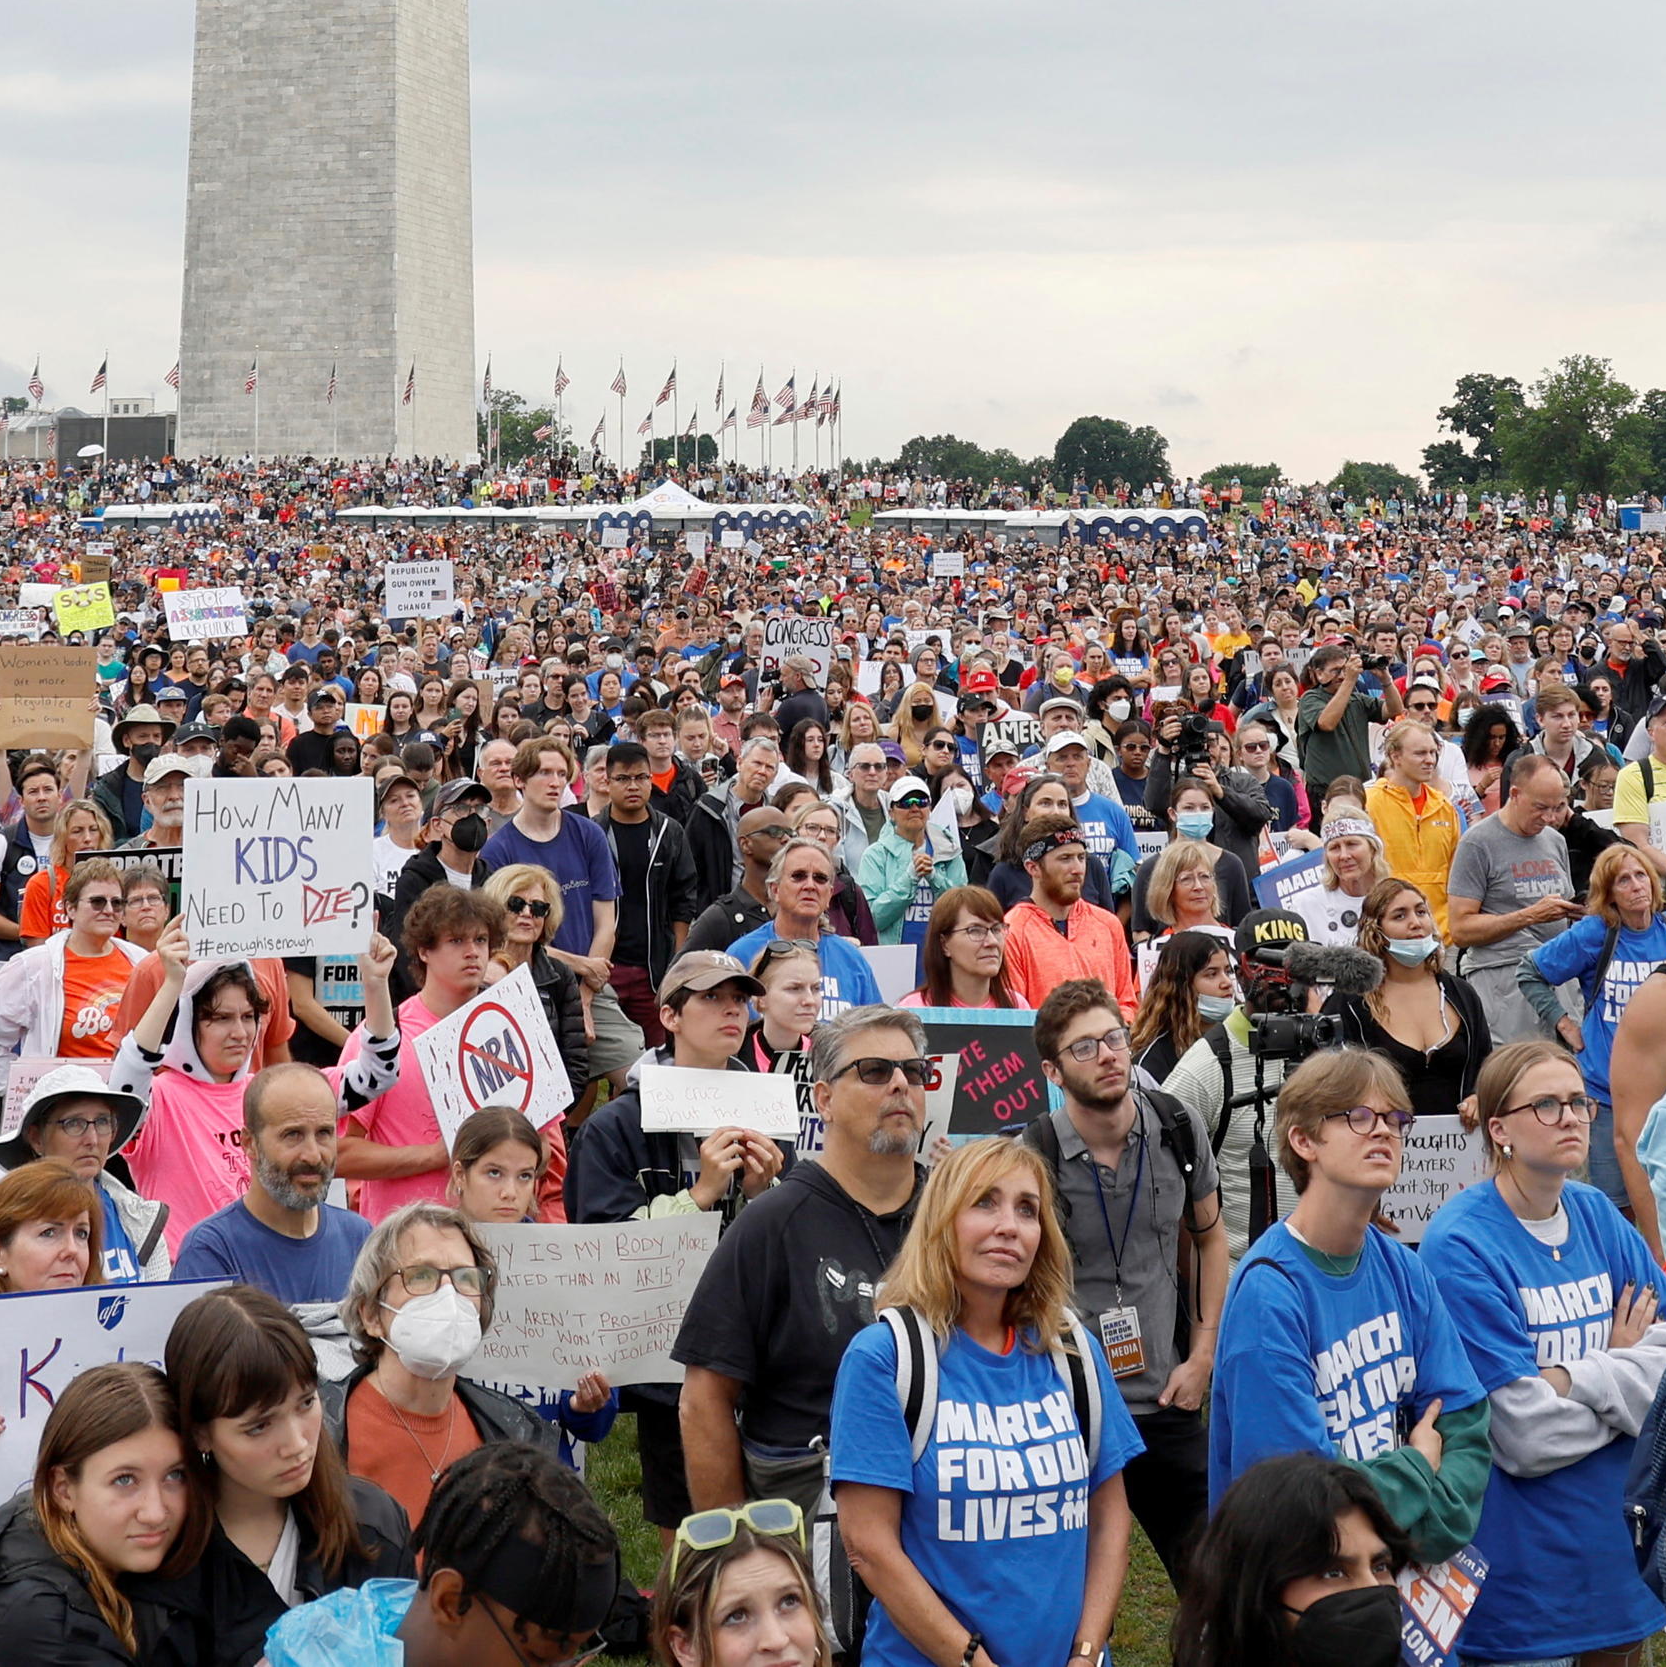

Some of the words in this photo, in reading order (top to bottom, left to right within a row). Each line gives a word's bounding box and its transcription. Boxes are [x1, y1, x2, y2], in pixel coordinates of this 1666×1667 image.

[391, 566, 440, 575] REPUBLICAN
[392, 580, 407, 588] GUN
[410, 579, 436, 587] OWNER
[177, 589, 228, 607] STOP
[408, 590, 424, 598] FOR
[398, 603, 431, 611] CHANGE
[765, 617, 832, 648] CONGRESS
[0, 655, 61, 669] Women's
[14, 677, 30, 686] are
[38, 676, 68, 686] more
[14, 695, 71, 710] Regulated
[11, 716, 35, 725] than
[982, 721, 1045, 747] AMER
[195, 789, 258, 833] HOW
[235, 836, 317, 885] KIDS
[1510, 859, 1558, 878] LOVE
[186, 888, 245, 932] NEED
[302, 882, 369, 929] DIE?
[1254, 918, 1304, 943] KING
[195, 937, 315, 957] #enoughisenough
[323, 965, 358, 982] FOR
[72, 1007, 113, 1038] Be
[469, 1026, 526, 1101] NRA
[962, 1051, 1026, 1102] THEM
[645, 1088, 674, 1102] Ted
[993, 1078, 1041, 1121] OUT
[655, 1106, 701, 1125] Shut
[1421, 1179, 1449, 1200] Stop
[528, 1243, 562, 1262] IS
[575, 1239, 608, 1263] MY
[556, 1273, 594, 1285] THAN
[604, 1272, 621, 1285] AN
[1518, 1271, 1614, 1325] MARCH
[525, 1307, 586, 1327] AREN'T
[1103, 1318, 1128, 1331] MARCH
[516, 1327, 544, 1338] YOU
[558, 1327, 605, 1347] WON'T
[617, 1331, 638, 1345] DO
[1104, 1328, 1117, 1337] FOR
[1118, 1325, 1132, 1335] OUR
[1105, 1334, 1124, 1343] LIVES
[483, 1344, 529, 1359] ABOUT
[1110, 1342, 1139, 1358] MEDIA
[1311, 1310, 1403, 1397] MARCH
[1362, 1357, 1417, 1410] OUR
[936, 1391, 1075, 1446] MARCH
[938, 1448, 1029, 1492] FOR
[938, 1491, 1059, 1542] LIVES
